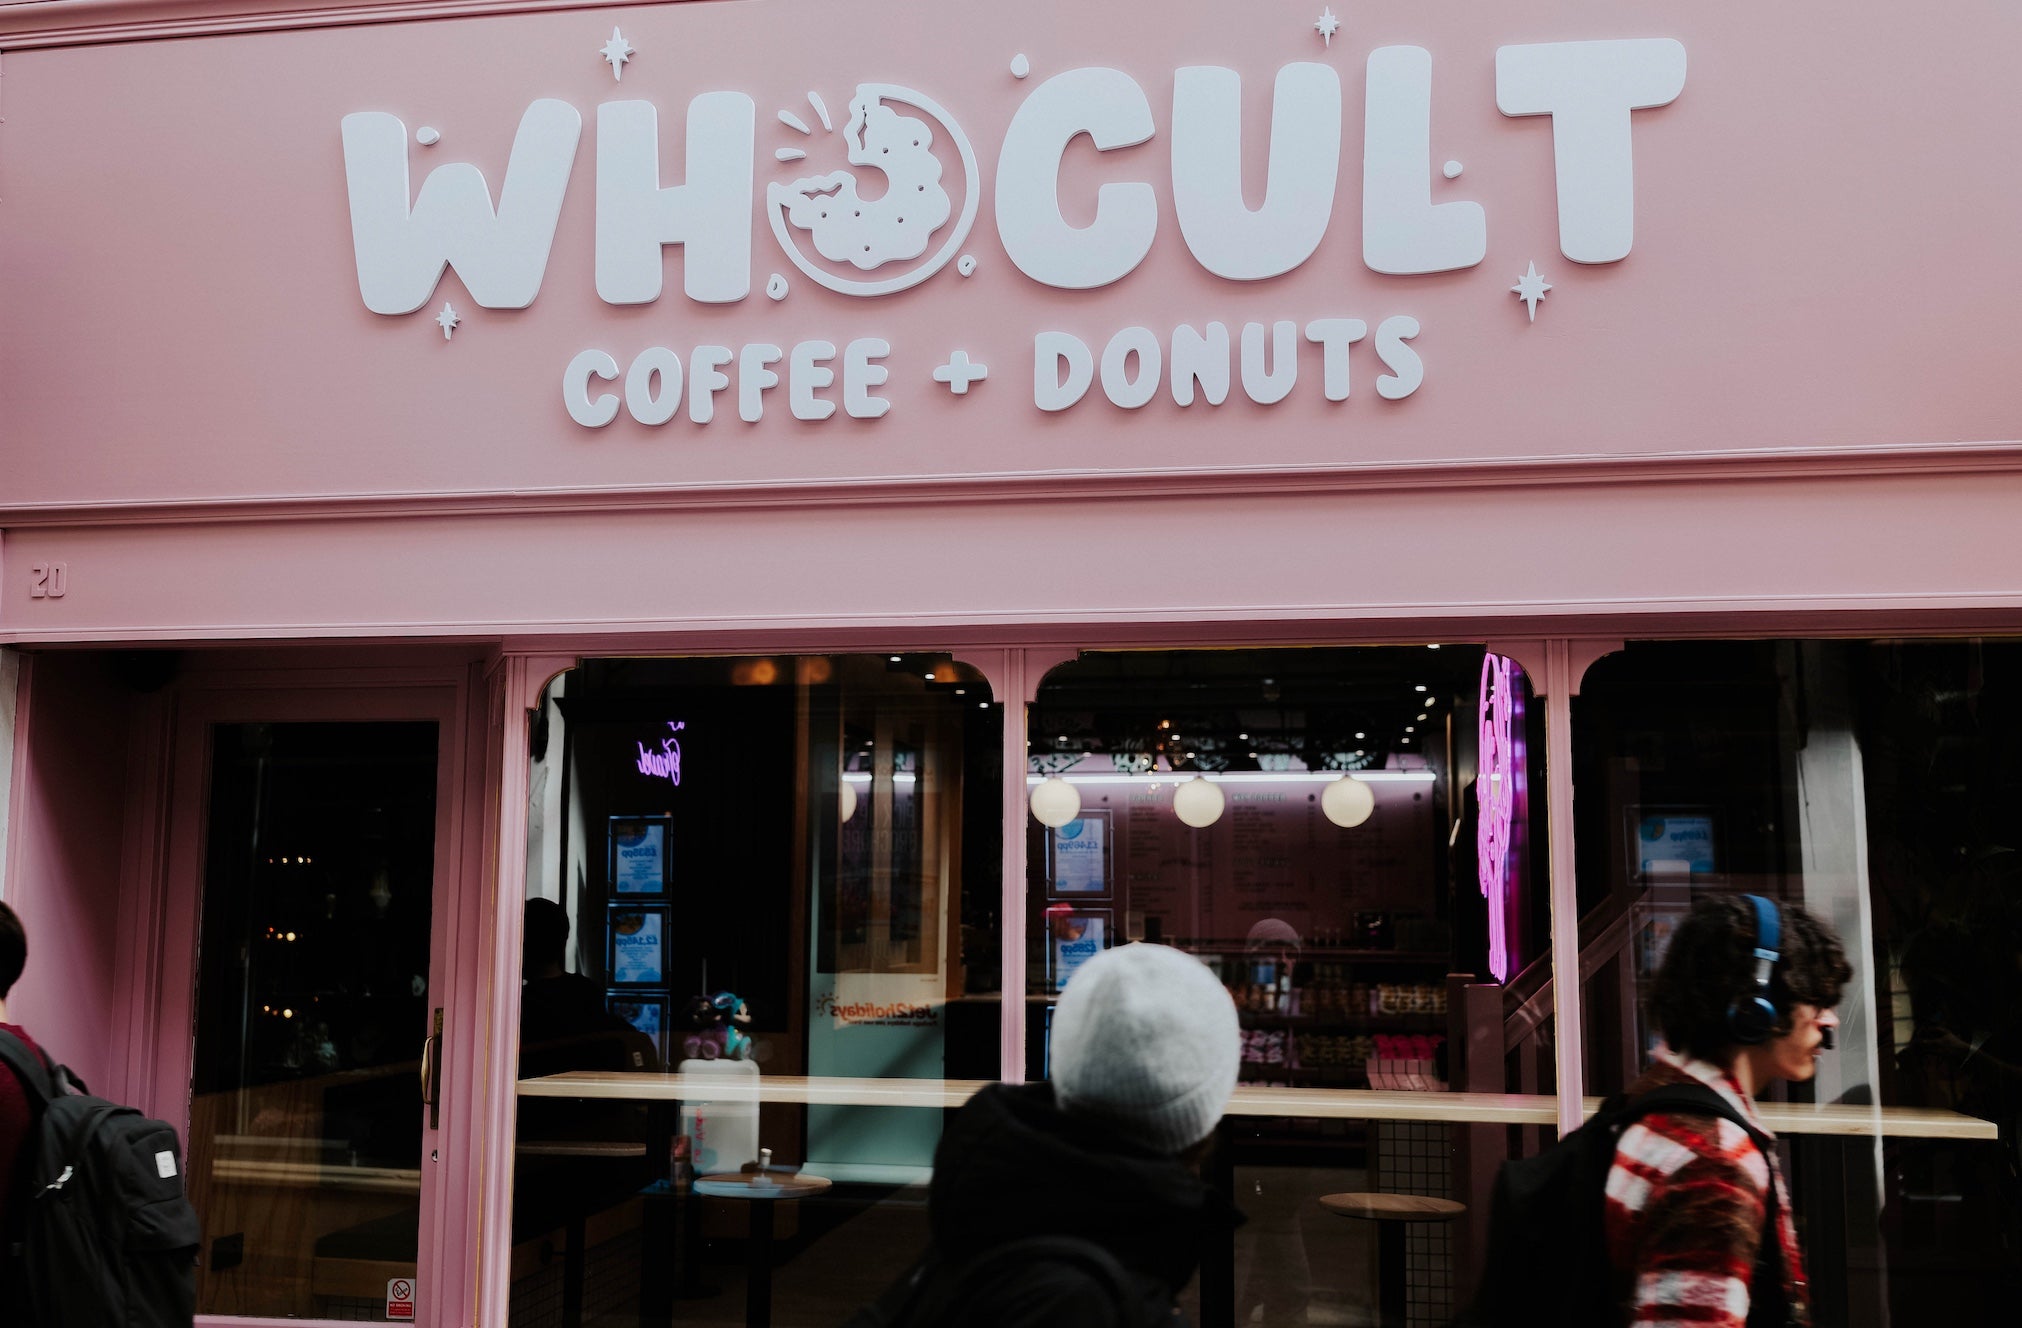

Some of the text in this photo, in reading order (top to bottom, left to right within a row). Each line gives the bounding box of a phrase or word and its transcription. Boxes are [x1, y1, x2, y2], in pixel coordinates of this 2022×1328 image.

[563, 338, 892, 429] COFFEE
[1034, 315, 1425, 412] DONUTS
[31, 561, 67, 599] 20
